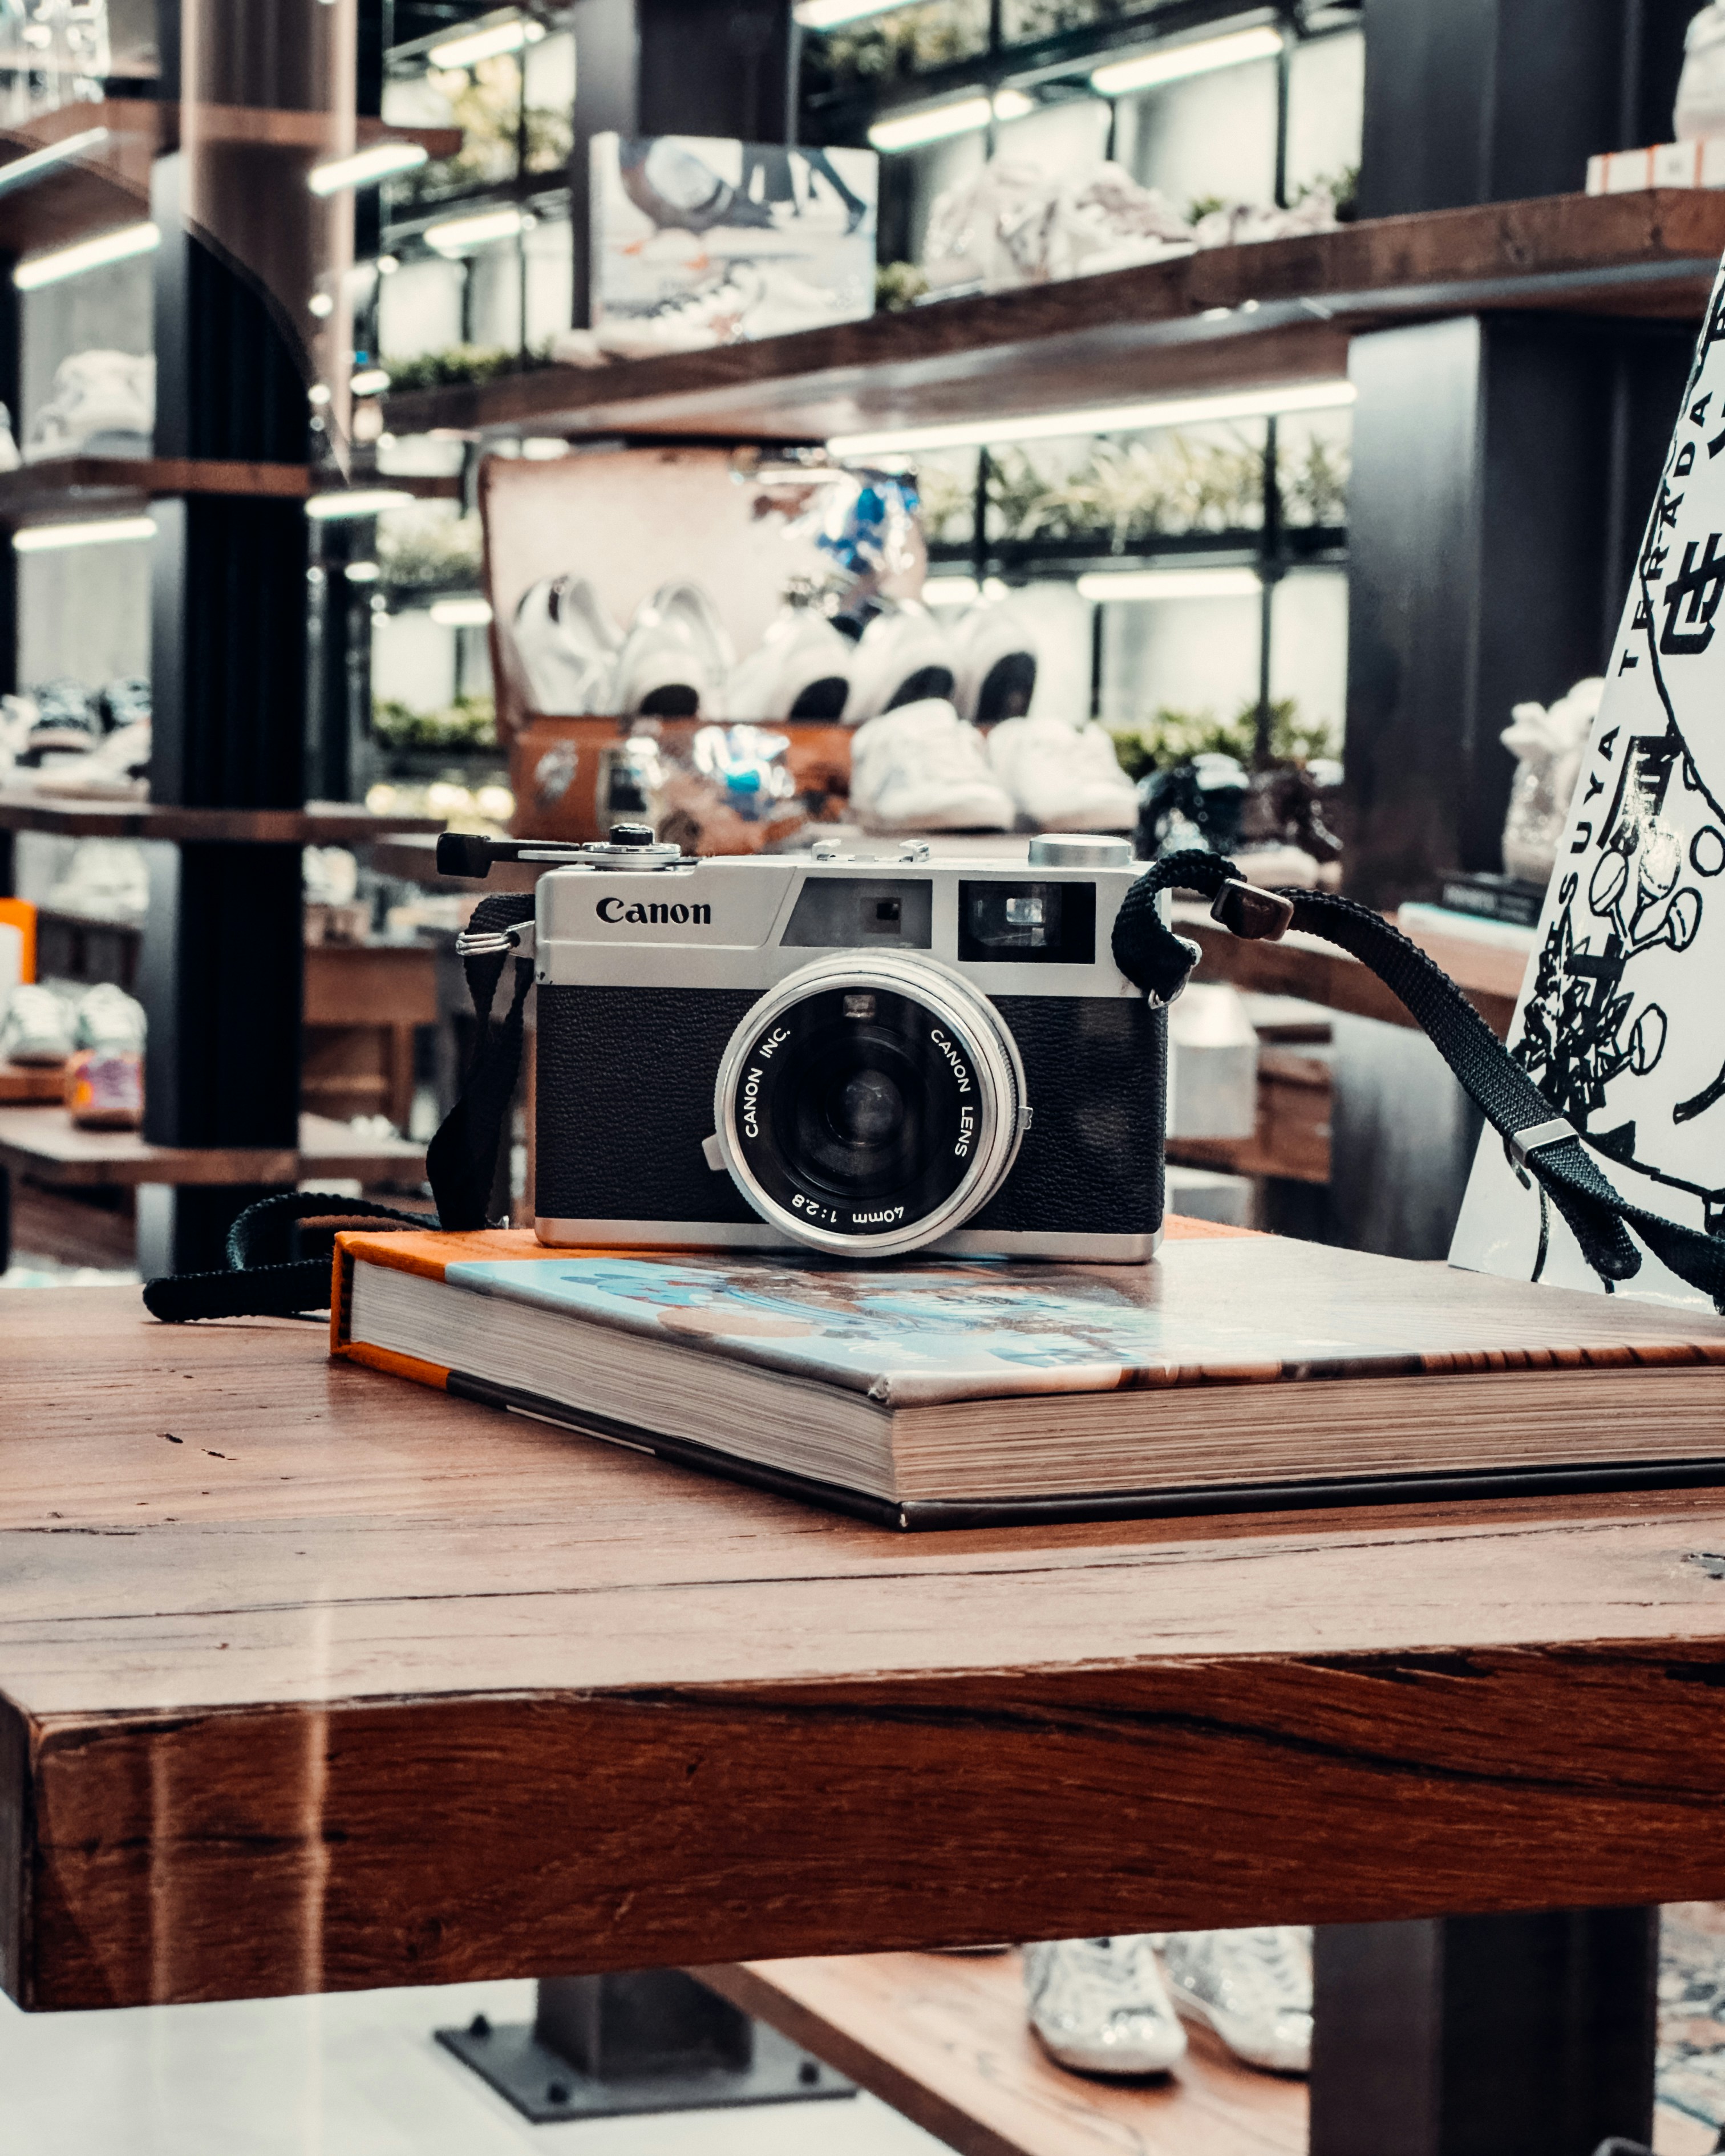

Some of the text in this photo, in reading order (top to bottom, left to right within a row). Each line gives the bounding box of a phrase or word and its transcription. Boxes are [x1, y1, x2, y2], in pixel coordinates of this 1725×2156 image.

[1618, 391, 1712, 677] TERADA
[596, 897, 711, 925] Canon
[743, 1027, 791, 1138] CANON INC.
[930, 1029, 974, 1157] CANON LENS
[852, 1206, 904, 1223] 40mm
